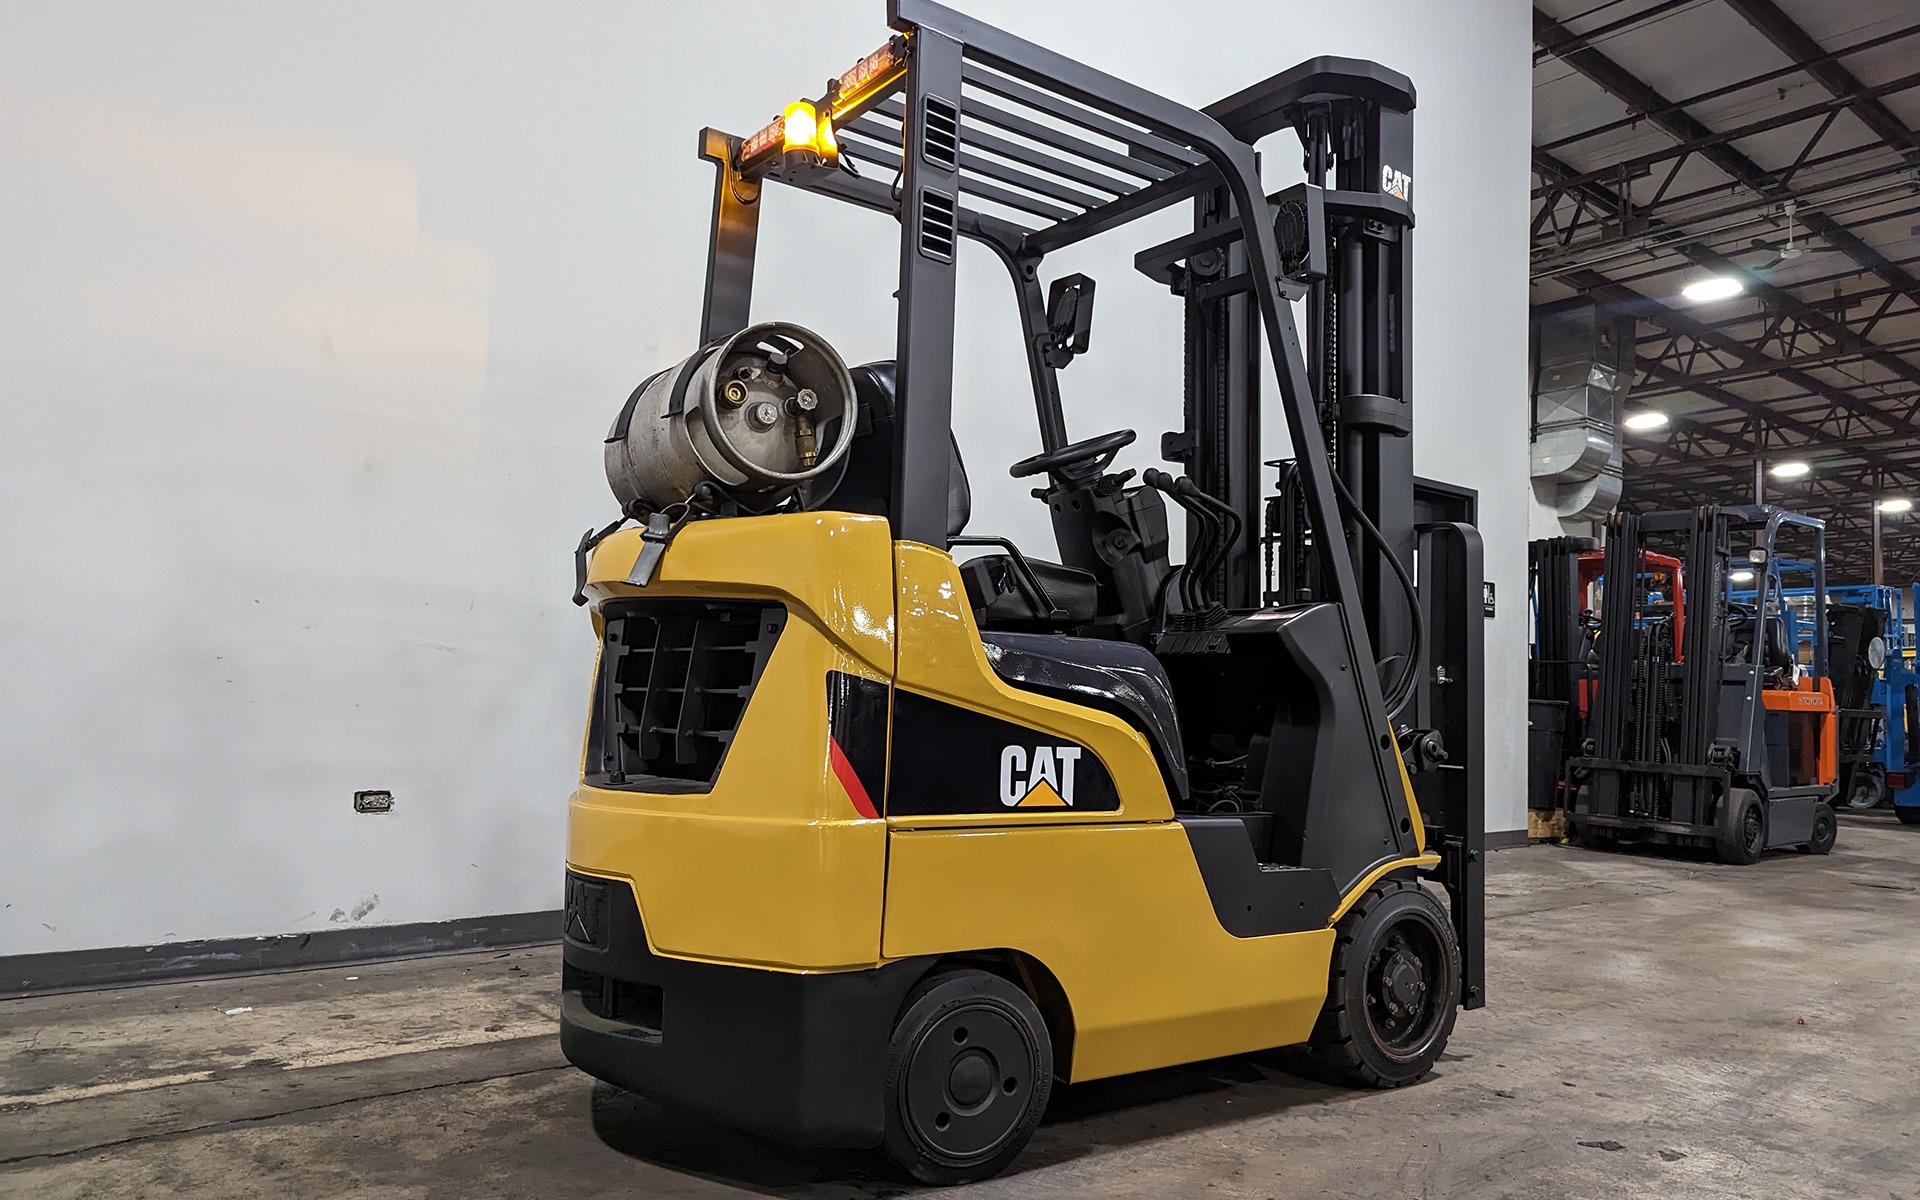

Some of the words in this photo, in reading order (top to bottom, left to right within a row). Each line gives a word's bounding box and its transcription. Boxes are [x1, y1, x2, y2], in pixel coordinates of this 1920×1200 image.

[1382, 165, 1411, 202] CAT
[1803, 697, 1825, 706] TOYOTA
[999, 744, 1082, 807] CAT
